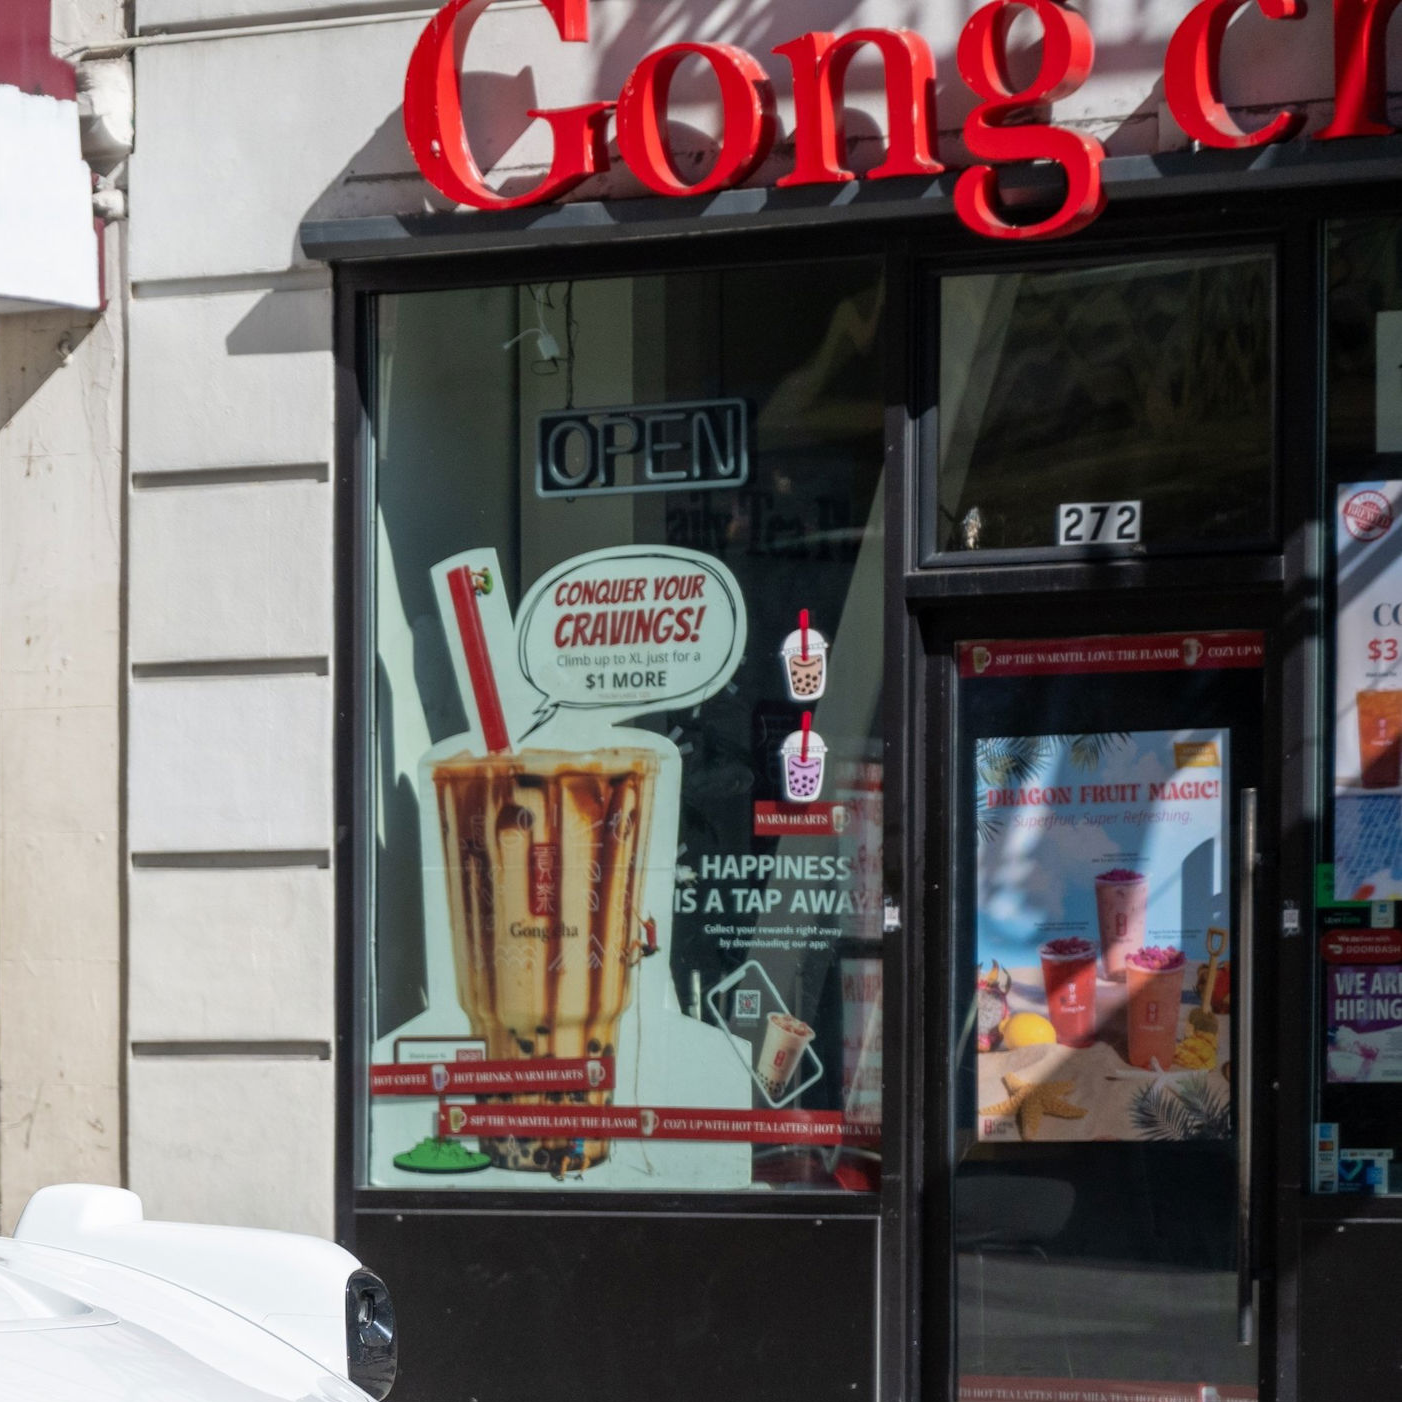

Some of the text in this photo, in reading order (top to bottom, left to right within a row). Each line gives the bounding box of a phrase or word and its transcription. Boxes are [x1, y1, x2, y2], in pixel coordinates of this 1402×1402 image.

[403, 0, 1108, 239] Gong
[544, 408, 741, 488] OPEN
[1062, 505, 1138, 543] 272
[554, 574, 706, 607] CONQUER YOUR
[554, 606, 707, 649] CRAVINGS!
[557, 649, 701, 670] Climb up to XL just for a
[996, 654, 1012, 665] SIP
[1015, 653, 1035, 665] THE
[1088, 651, 1115, 663] LOVE
[1118, 650, 1138, 662] THE
[1140, 648, 1180, 661] FLAVOR
[1208, 645, 1234, 657] COZY
[1236, 644, 1252, 656] UP
[585, 670, 667, 690] $1 MORE
[987, 779, 1220, 807] DRAGON FRUIT MAGIC!
[757, 813, 828, 825] WARM HEARTS
[1083, 811, 1118, 826] Super
[1123, 809, 1193, 826] Refreshing.
[701, 854, 852, 880] HAPPINESS
[673, 888, 697, 914] IS
[704, 888, 724, 914] A
[731, 888, 783, 914] TAP
[704, 924, 843, 936] Collect your rewards right away
[720, 938, 731, 949] by
[733, 938, 790, 950] downloading
[792, 940, 807, 948] our
[1335, 973, 1366, 995] WE
[373, 1075, 392, 1086] HOT
[394, 1074, 428, 1085] COFFEE
[454, 1072, 473, 1083] HOT
[515, 1070, 544, 1082] WARM
[545, 1069, 584, 1081] HEARTS
[470, 1115, 485, 1126] SIP
[488, 1115, 504, 1126] THE
[554, 1116, 578, 1127] LOVE
[581, 1116, 599, 1128] THE
[601, 1116, 638, 1129] FLAVOR
[663, 1119, 687, 1130] COZY
[689, 1120, 703, 1131] UP
[704, 1120, 730, 1131] WITH
[731, 1121, 753, 1132] HOT
[754, 1121, 772, 1132] TEA
[773, 1122, 809, 1133] LATTES
[814, 1123, 836, 1134] HOT
[838, 1124, 861, 1136] MILK
[863, 1125, 882, 1136] TEA
